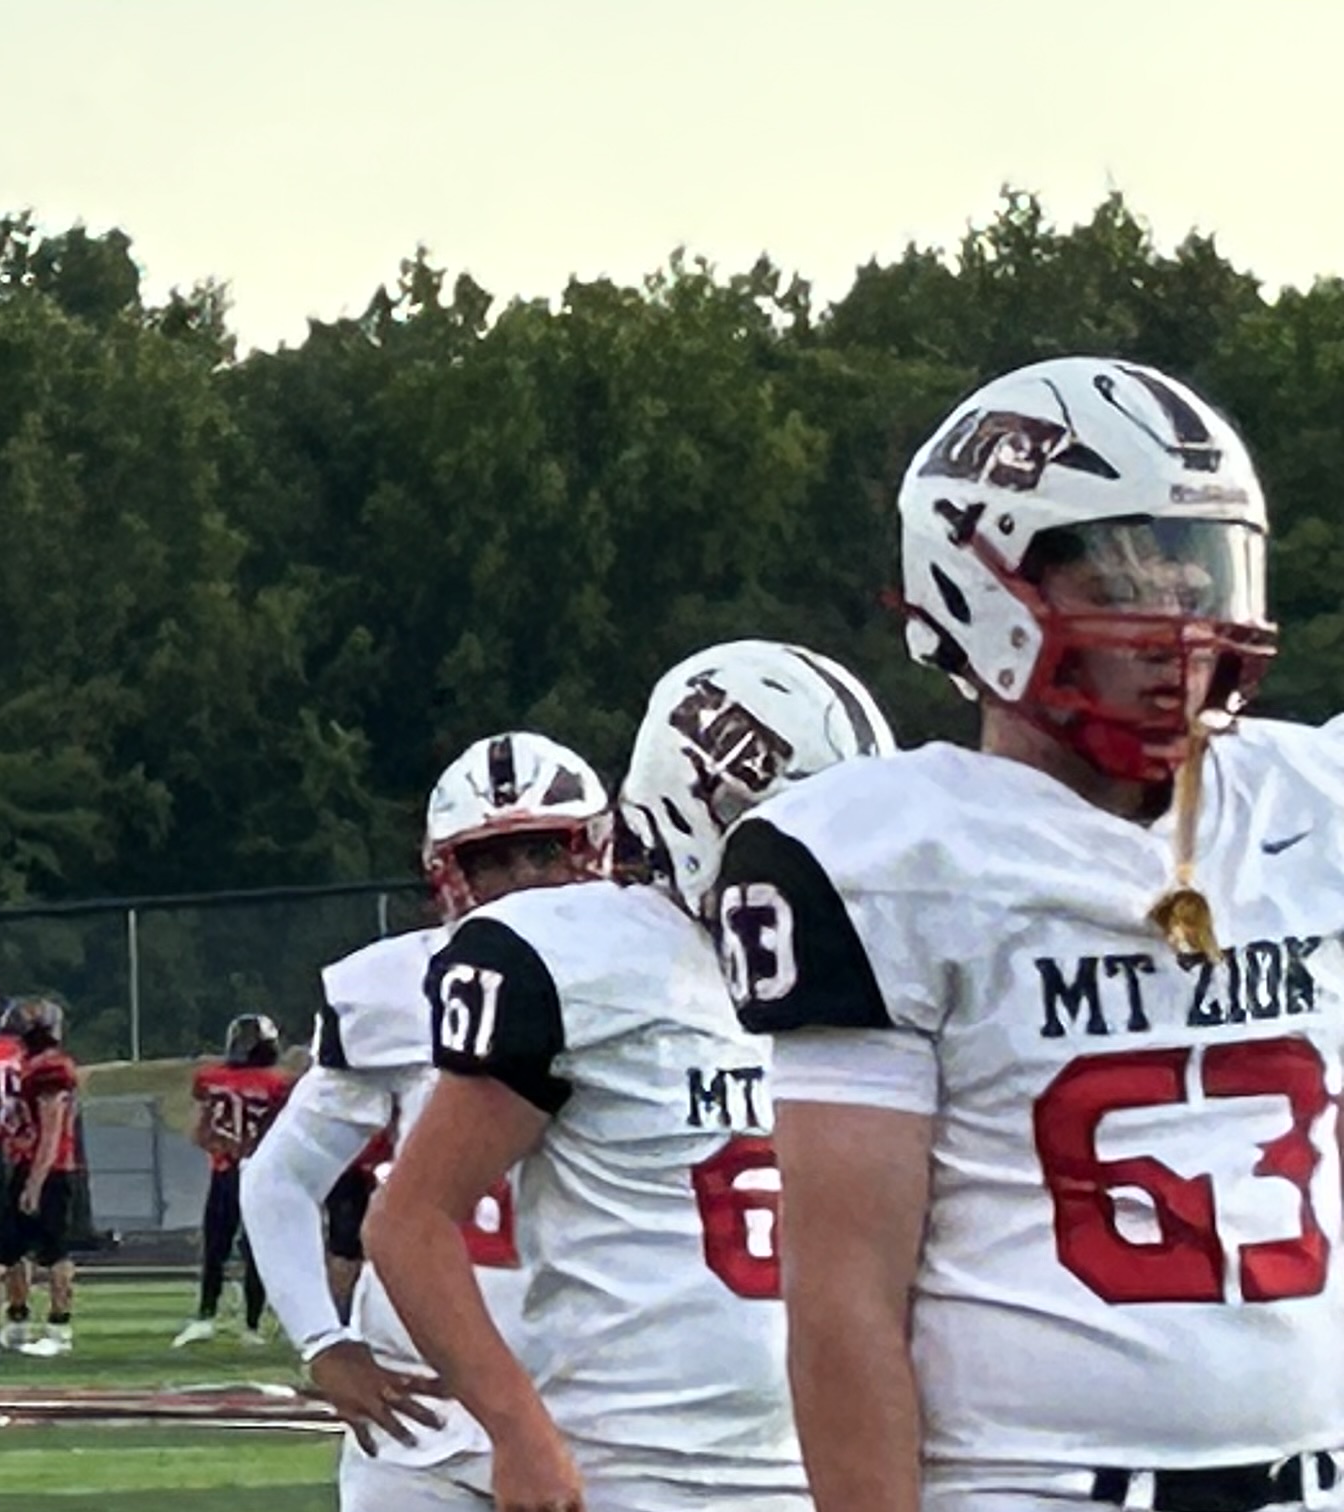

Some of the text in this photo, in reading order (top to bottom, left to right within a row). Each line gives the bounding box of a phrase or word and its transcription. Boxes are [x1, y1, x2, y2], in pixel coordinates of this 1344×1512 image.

[439, 964, 504, 1057] 61
[1034, 935, 1323, 1037] MT ZION
[687, 1066, 766, 1128] MT
[1032, 1036, 1330, 1305] 63
